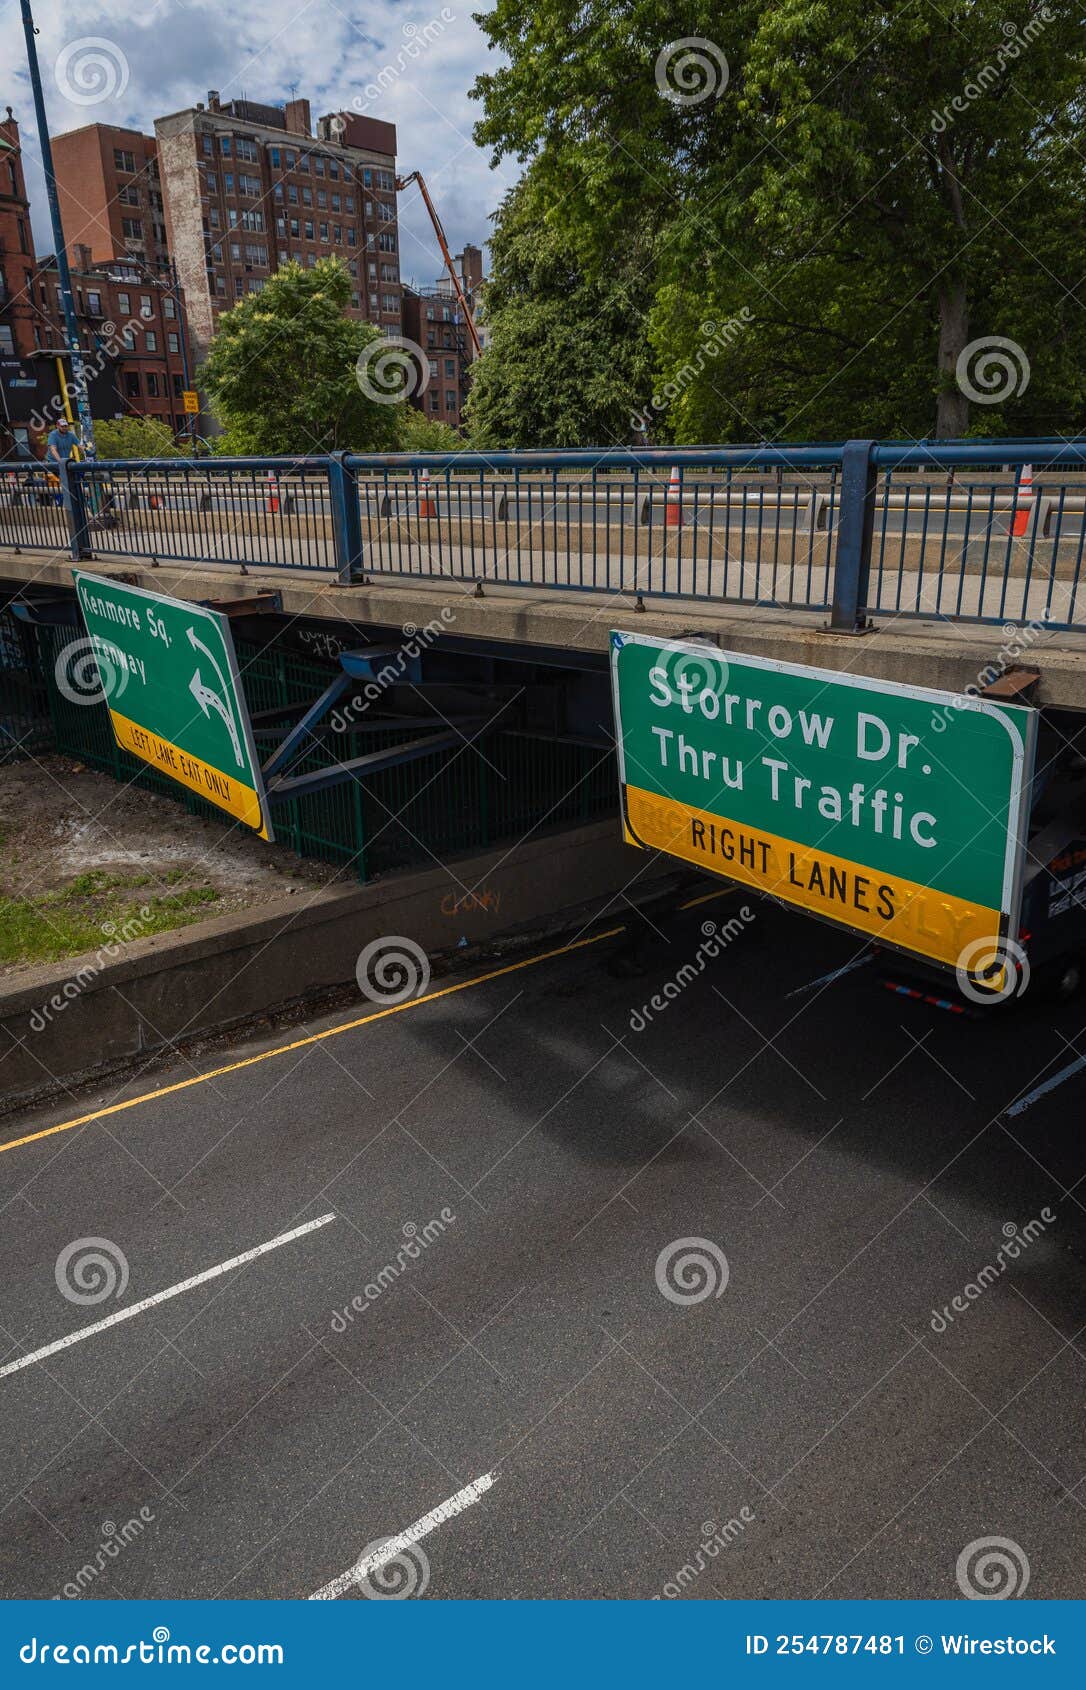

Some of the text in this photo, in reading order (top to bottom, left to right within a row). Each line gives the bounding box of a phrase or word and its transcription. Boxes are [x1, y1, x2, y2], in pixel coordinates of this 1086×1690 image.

[81, 586, 173, 649] Kenmore Sq.
[93, 633, 146, 686] Fenway
[130, 726, 231, 802] LEFT LANE EXIT ONLY
[648, 665, 932, 775] Storrow Dr.
[651, 726, 938, 848] Thru Traffic
[691, 817, 895, 921] RIGHT LANES
